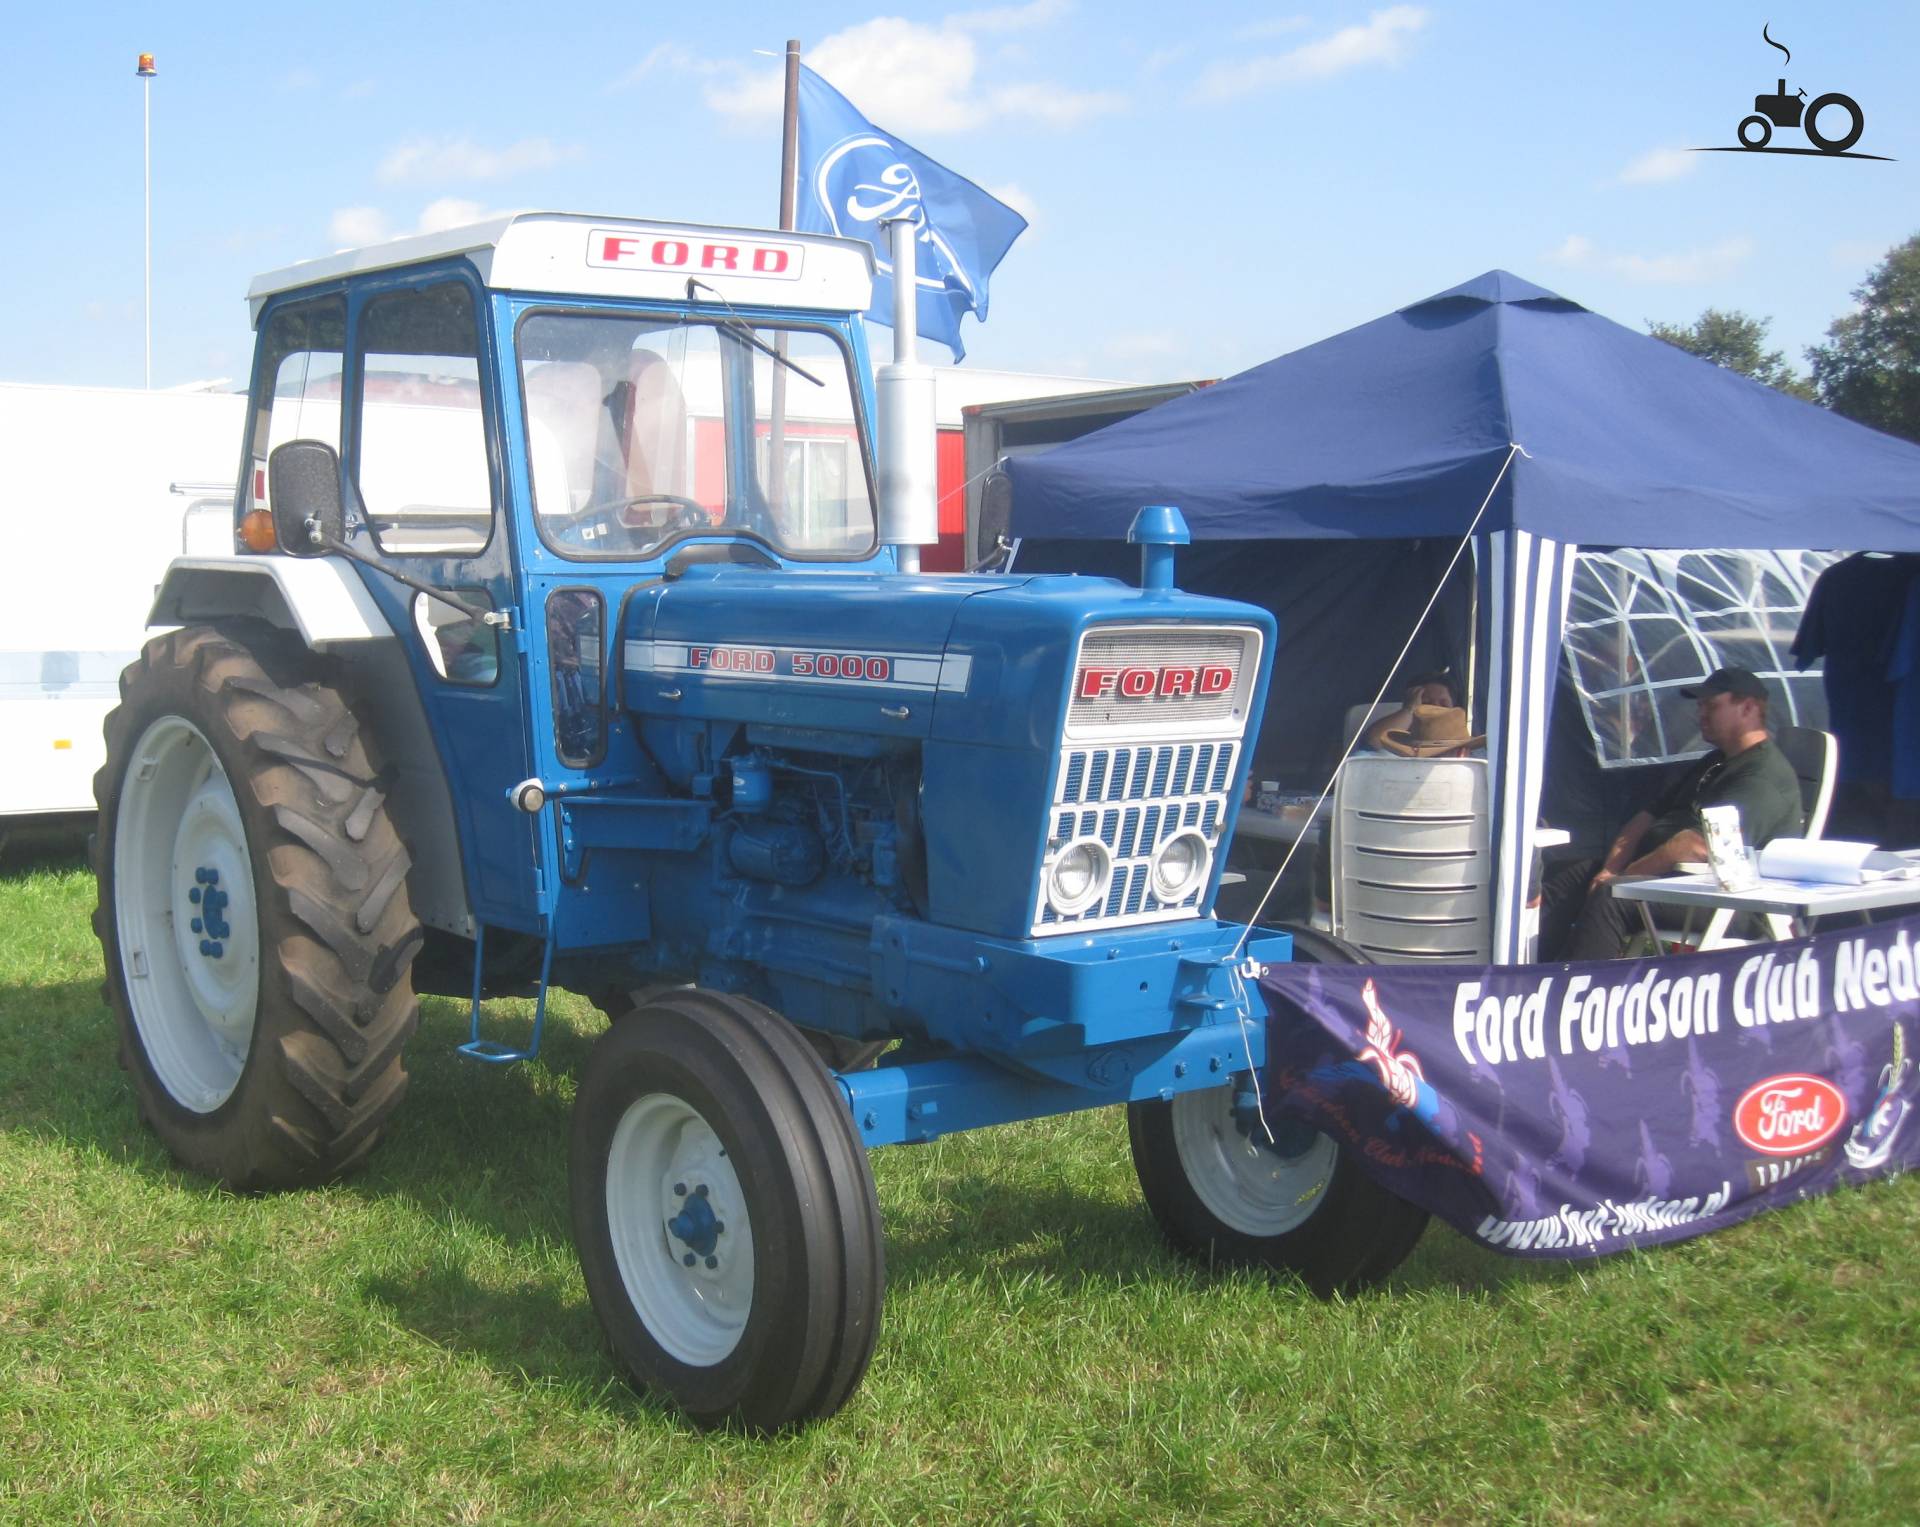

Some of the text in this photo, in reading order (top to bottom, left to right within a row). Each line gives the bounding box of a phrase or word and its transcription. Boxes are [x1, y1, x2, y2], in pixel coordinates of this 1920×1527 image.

[602, 237, 789, 273] FORD
[690, 647, 889, 681] FORD 5000
[1077, 666, 1233, 698] FORD
[1453, 930, 1920, 1064] Ford Fordson Club Ned
[1757, 1087, 1824, 1140] Ford
